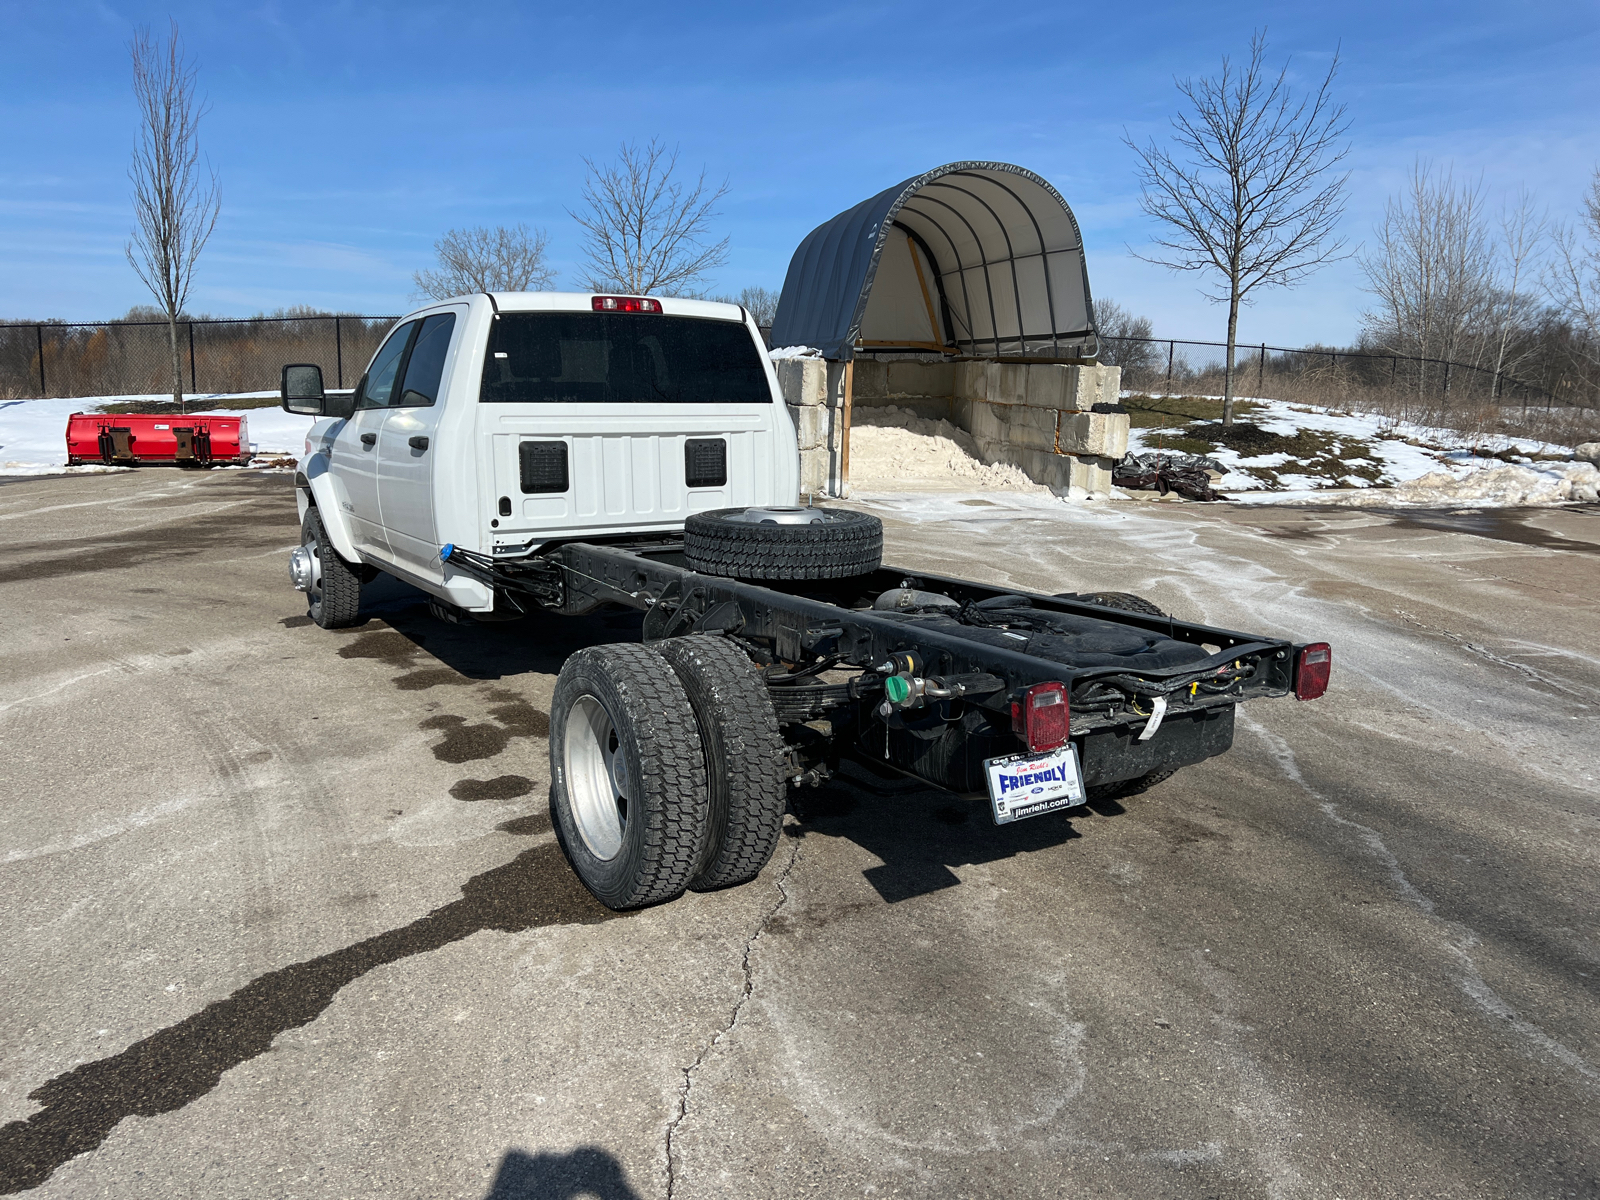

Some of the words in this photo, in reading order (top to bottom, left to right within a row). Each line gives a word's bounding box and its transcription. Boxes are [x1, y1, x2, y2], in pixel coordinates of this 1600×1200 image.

[998, 761, 1067, 795] FRIENDLY
[1016, 765, 1028, 775] Jim
[1015, 797, 1068, 818] jimriehl.com
